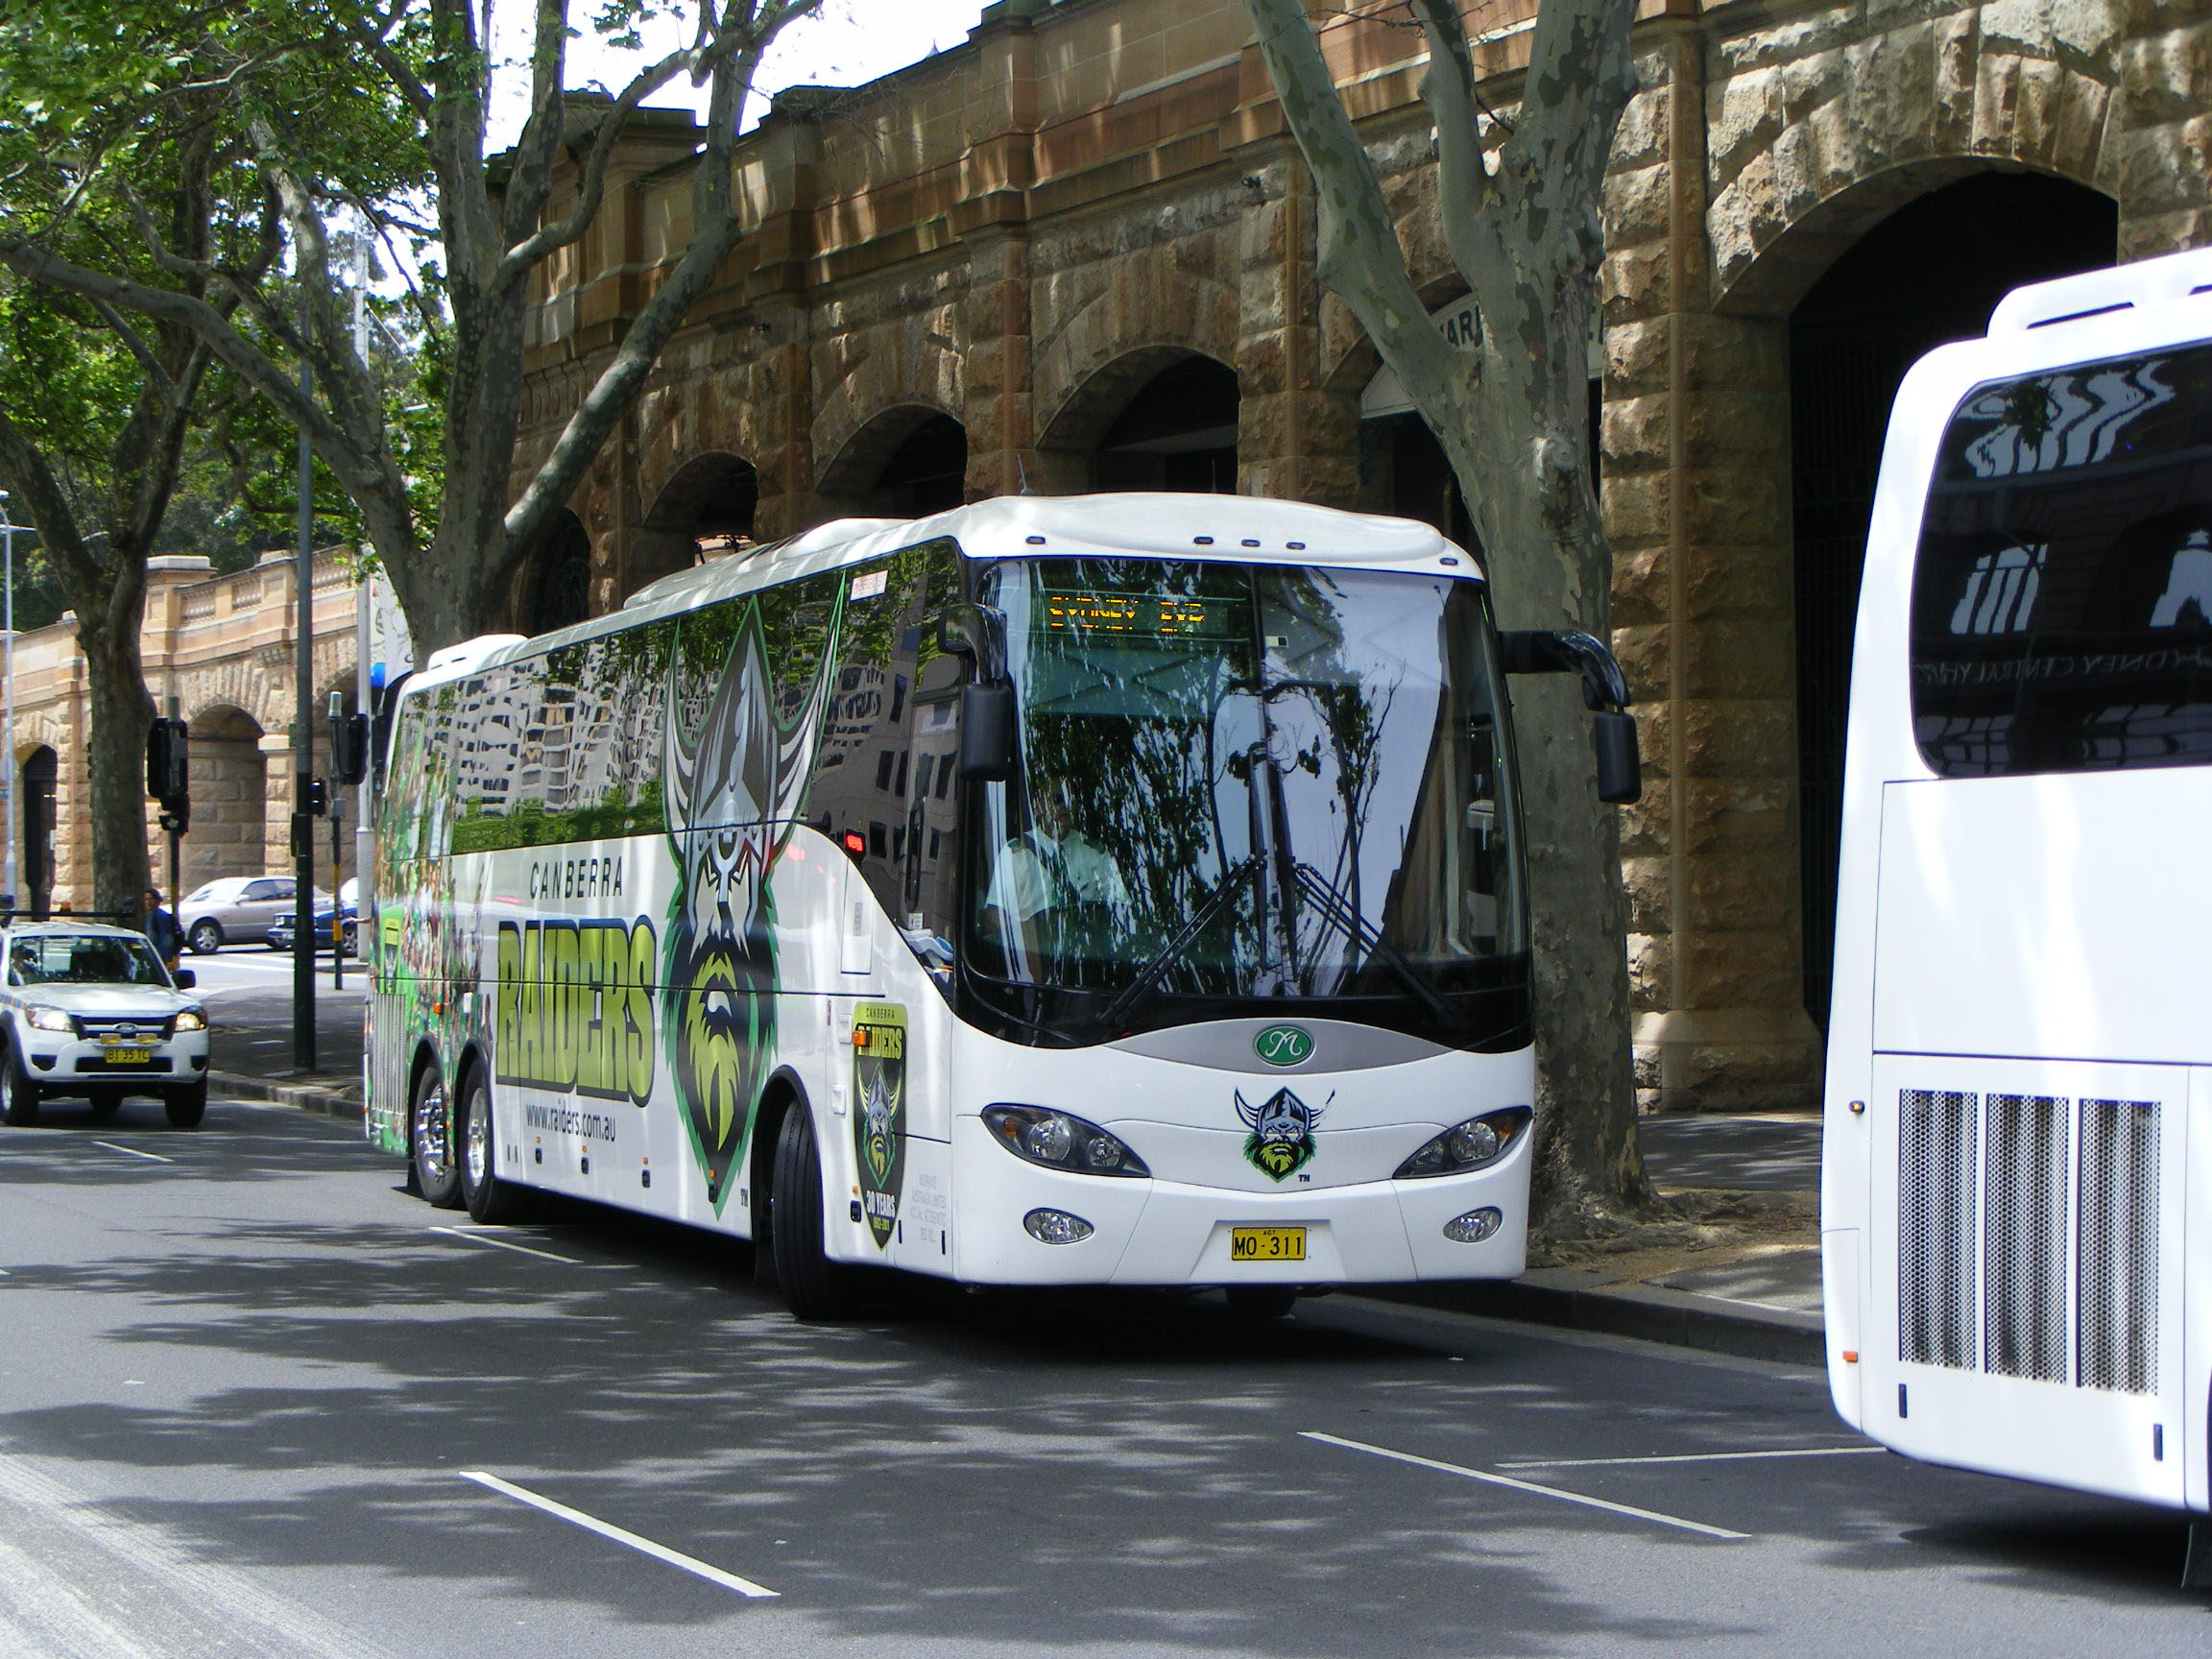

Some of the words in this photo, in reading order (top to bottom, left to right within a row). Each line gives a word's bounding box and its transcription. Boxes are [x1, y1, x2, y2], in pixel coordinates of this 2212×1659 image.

[1439, 304, 1484, 348] AR
[530, 855, 622, 900] CANBERRA
[496, 914, 657, 1108] RAIDERS
[866, 1007, 895, 1019] CANBERRA
[122, 1048, 134, 1061] 35
[525, 1098, 616, 1142] www.raiders.com.au
[1298, 1174, 1310, 1183] TM
[740, 1187, 749, 1209] TM
[866, 1190, 876, 1214] 30
[876, 1191, 896, 1219] YEARS
